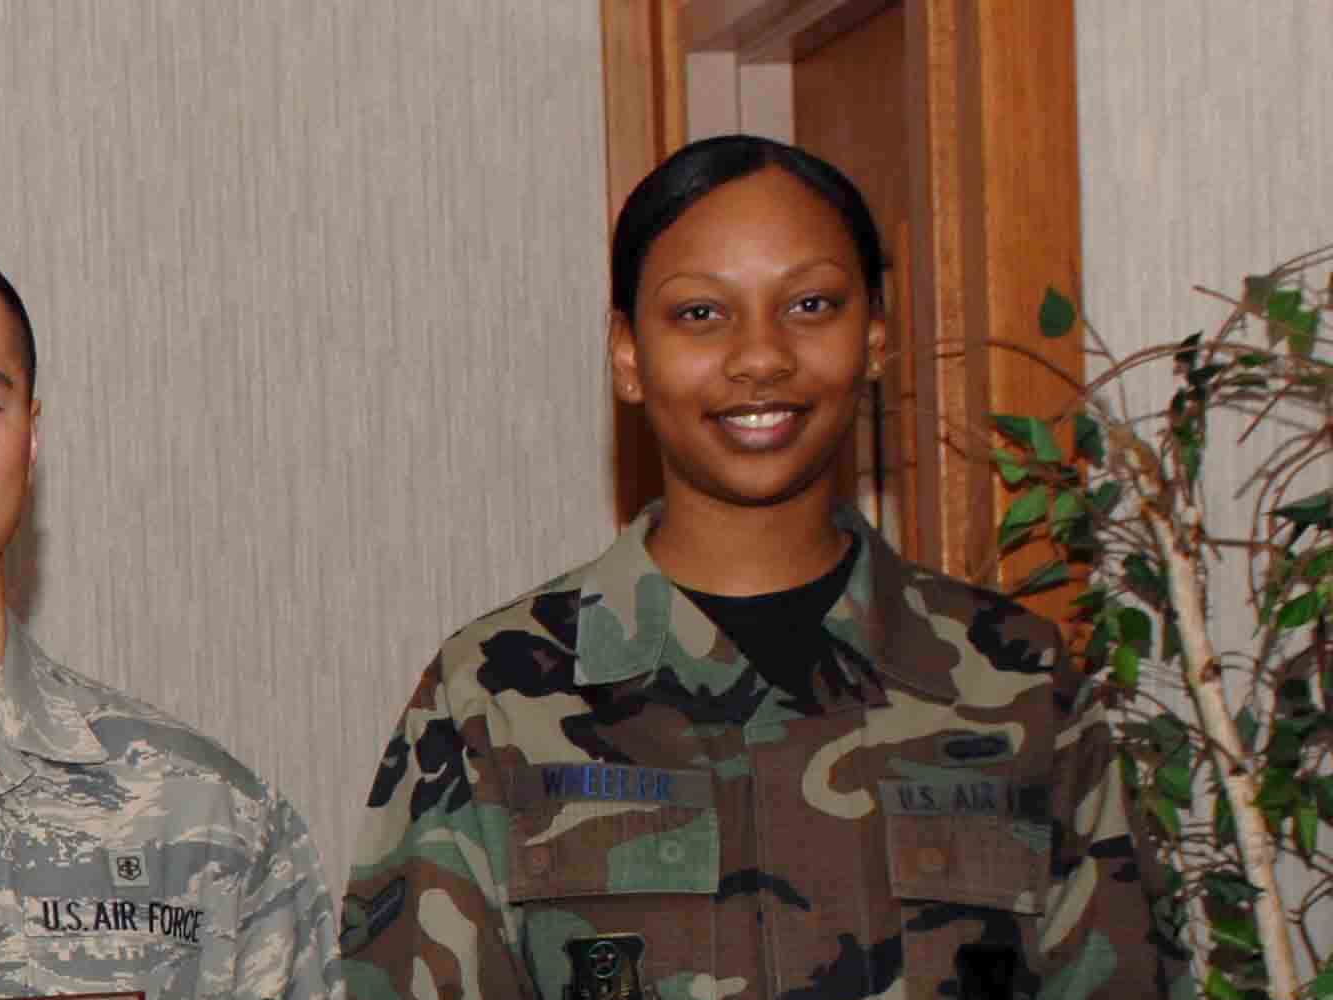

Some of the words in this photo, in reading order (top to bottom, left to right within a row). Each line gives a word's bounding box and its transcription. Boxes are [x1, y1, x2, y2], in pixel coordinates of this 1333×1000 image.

[42, 901, 88, 931] U.S.
[93, 901, 138, 931] AIR
[149, 902, 204, 942] FORCE
